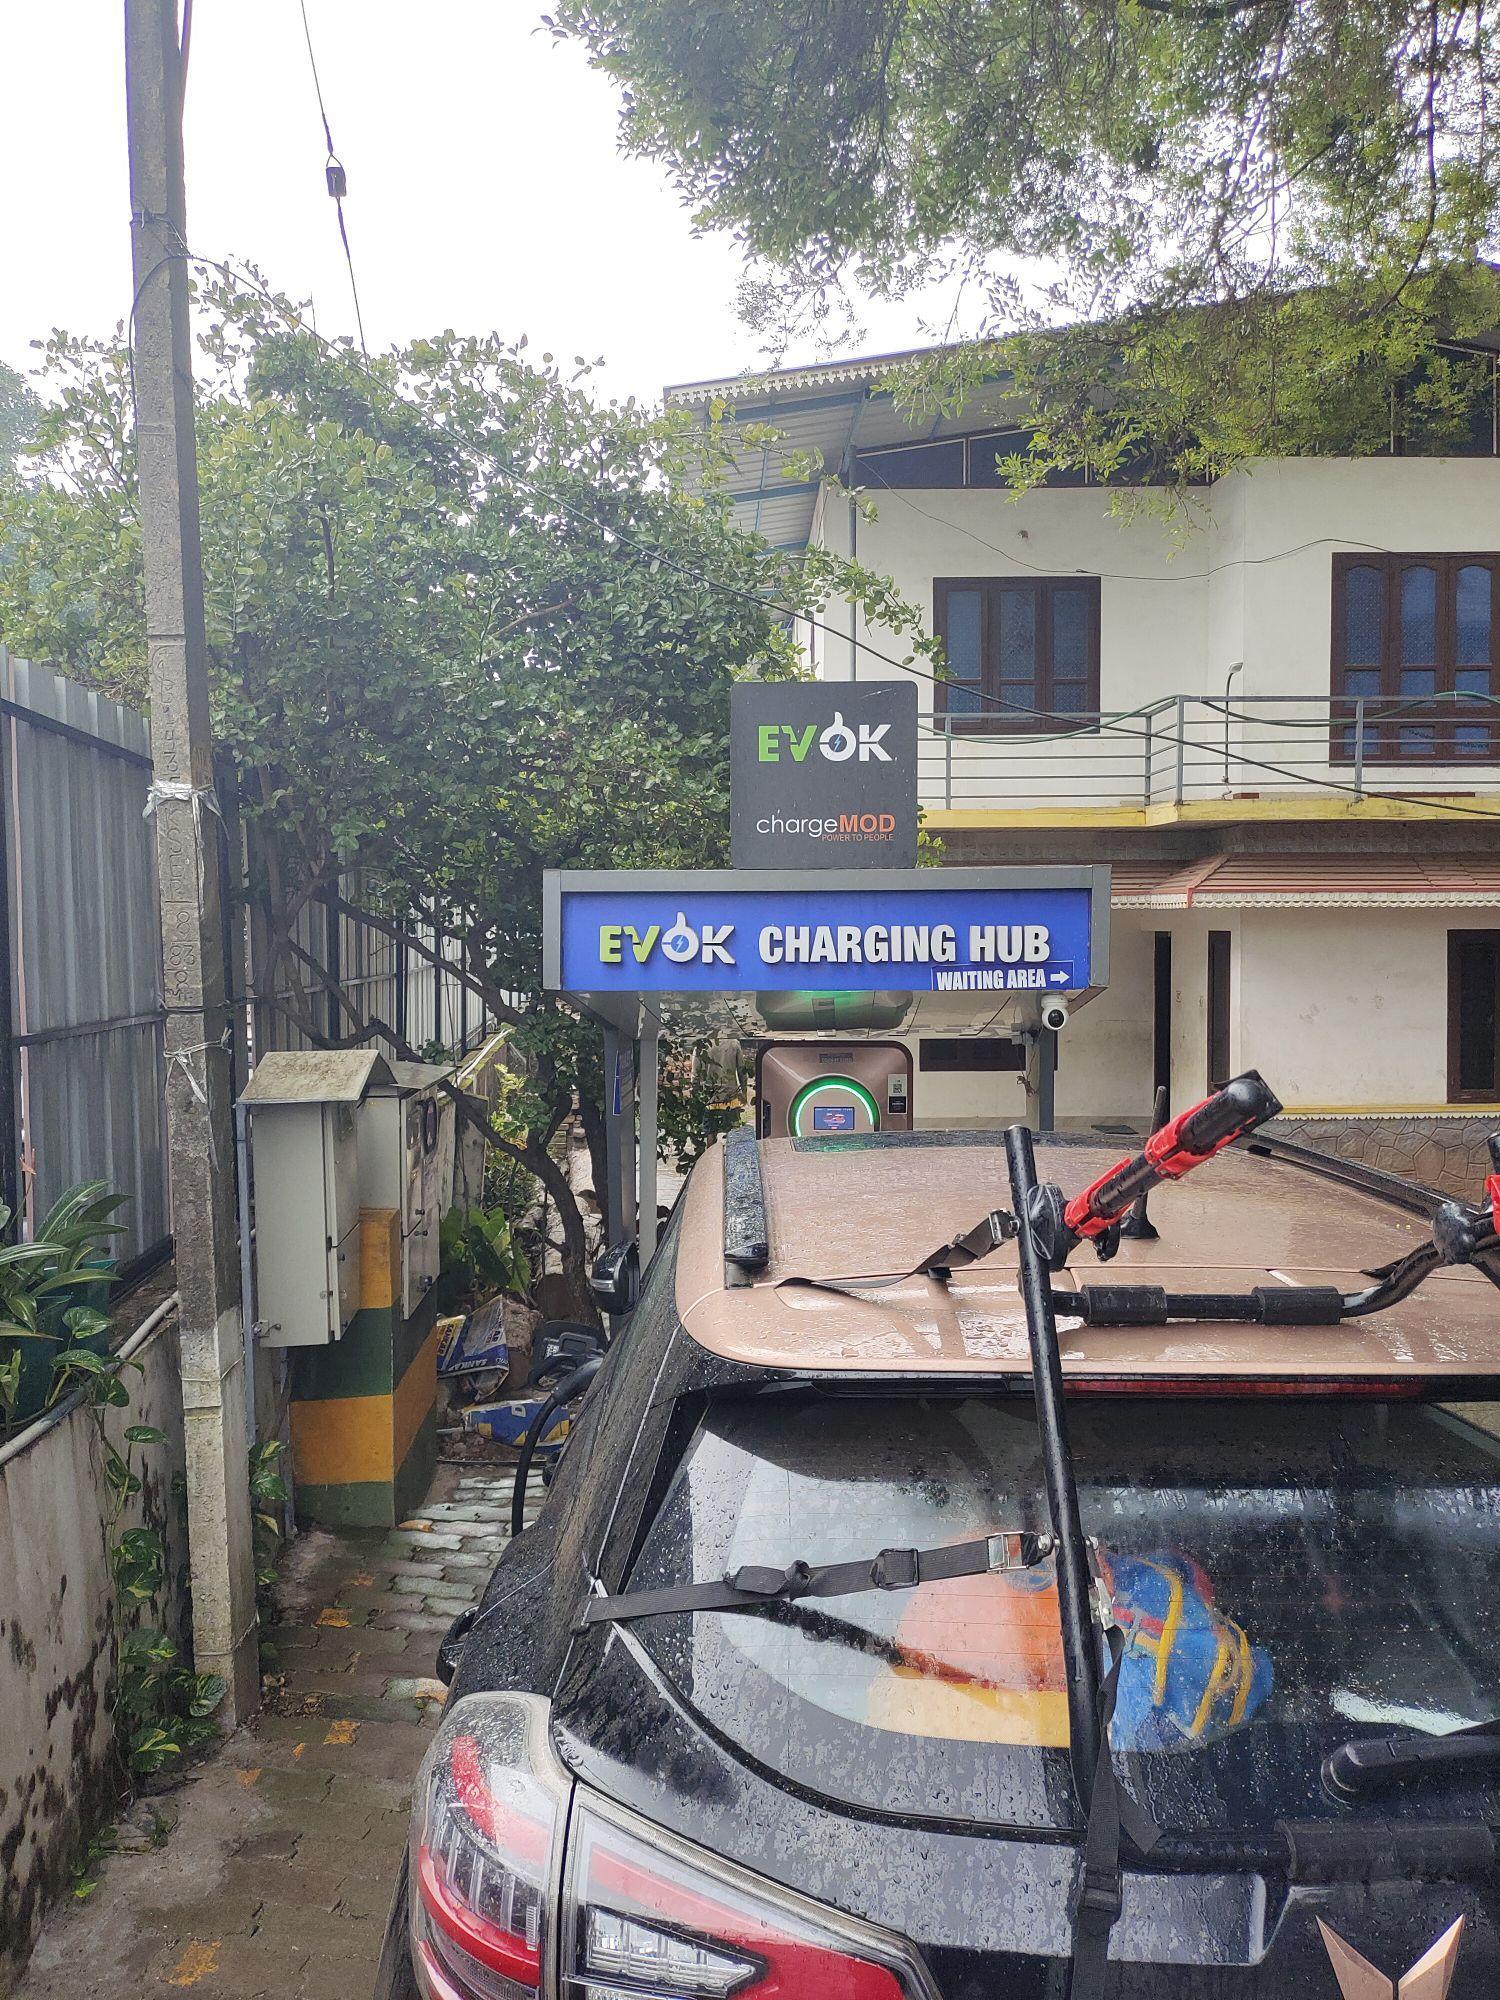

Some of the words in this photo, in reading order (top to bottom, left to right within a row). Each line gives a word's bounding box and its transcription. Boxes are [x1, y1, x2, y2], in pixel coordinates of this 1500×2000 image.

[758, 711, 893, 762] EVOK
[756, 814, 896, 838] chargeMOD
[822, 833, 850, 842] POWER
[852, 833, 863, 842] TO
[864, 833, 894, 842] PEOPLE
[599, 911, 736, 964] EVOK
[758, 924, 956, 964] CHARGING
[969, 925, 1050, 963] HUB
[936, 970, 1004, 991] WAITING
[1007, 968, 1047, 989] AREA
